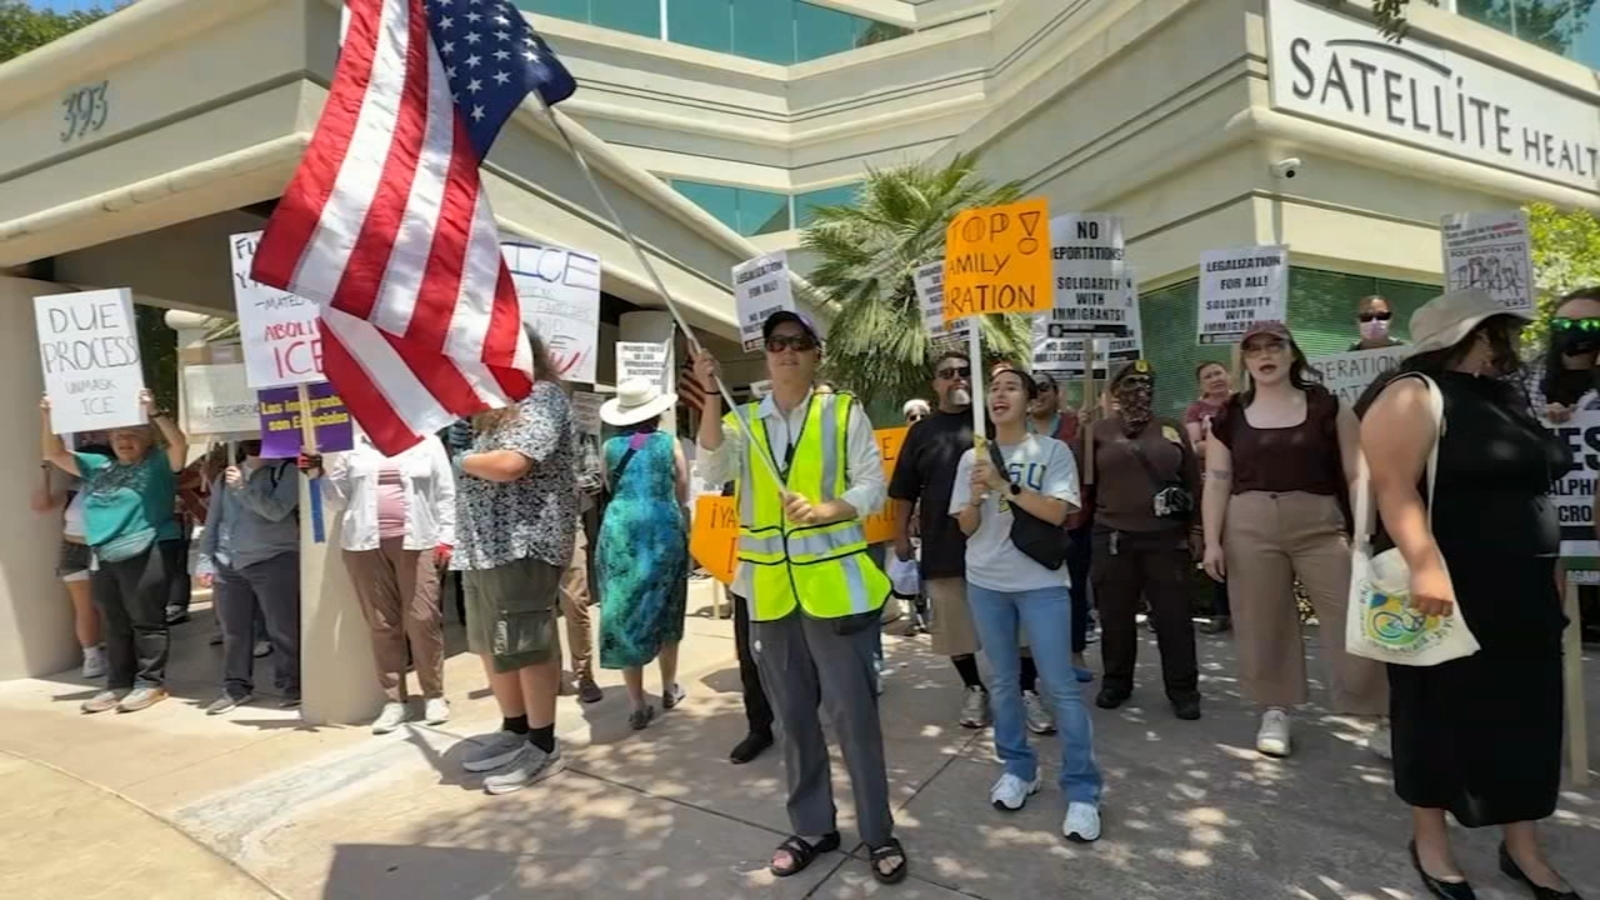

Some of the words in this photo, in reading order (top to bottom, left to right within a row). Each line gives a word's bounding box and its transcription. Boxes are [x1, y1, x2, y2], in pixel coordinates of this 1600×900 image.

[59, 80, 109, 142] 393
[1077, 220, 1099, 239] NO
[500, 241, 598, 291] ICE
[949, 252, 1011, 276] AMILY
[1206, 255, 1281, 273] LEGALIZATION
[1057, 276, 1120, 290] SOLIDARITY
[1220, 278, 1242, 290] FOR
[1244, 275, 1268, 288] ALL!
[951, 284, 1036, 313] RATION
[1075, 292, 1105, 306] WITH
[1206, 297, 1271, 310] SOLIDARITY
[49, 303, 120, 334] DUE
[1053, 308, 1125, 321] IMMIGRANTS!
[1225, 309, 1255, 320] WITH
[264, 321, 319, 342] ABOLI
[42, 335, 139, 374] PROCESS
[274, 340, 323, 379] ICE
[64, 379, 116, 395] UNMASK
[80, 396, 117, 416] ICE
